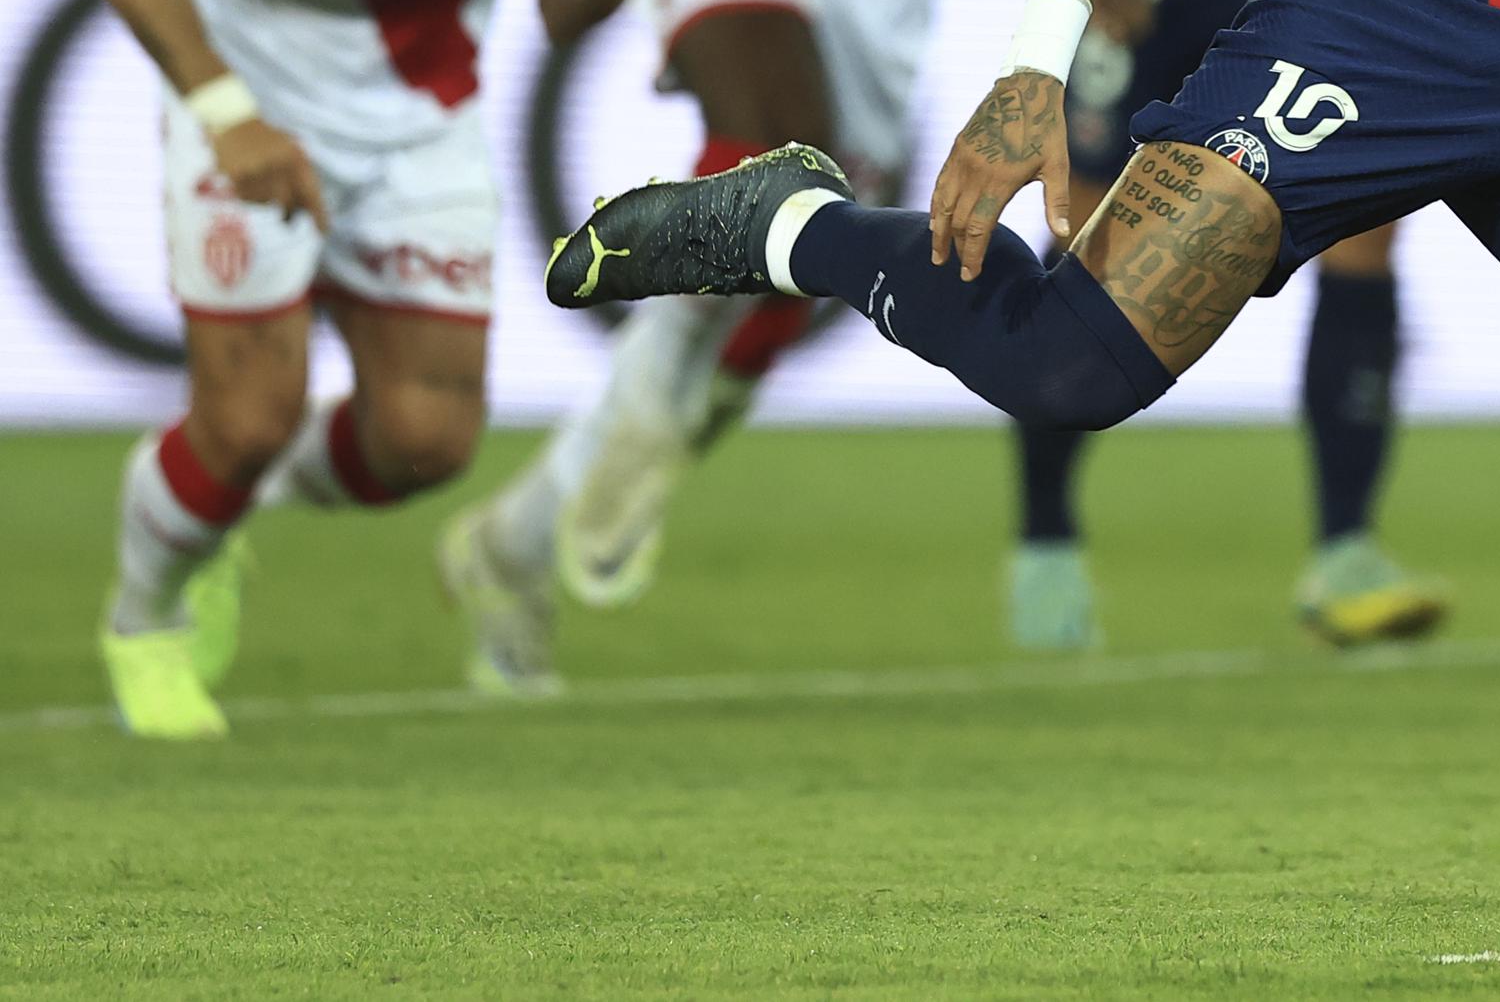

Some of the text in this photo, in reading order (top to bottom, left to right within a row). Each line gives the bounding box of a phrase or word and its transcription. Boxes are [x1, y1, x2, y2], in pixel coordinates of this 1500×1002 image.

[1253, 60, 1359, 152] 10
[1168, 148, 1204, 177] NÃO
[1224, 132, 1265, 163] PARIS
[1142, 160, 1156, 174] O
[1155, 169, 1202, 202] QUÃO
[1126, 182, 1150, 201] EU
[1146, 196, 1186, 224] SOU
